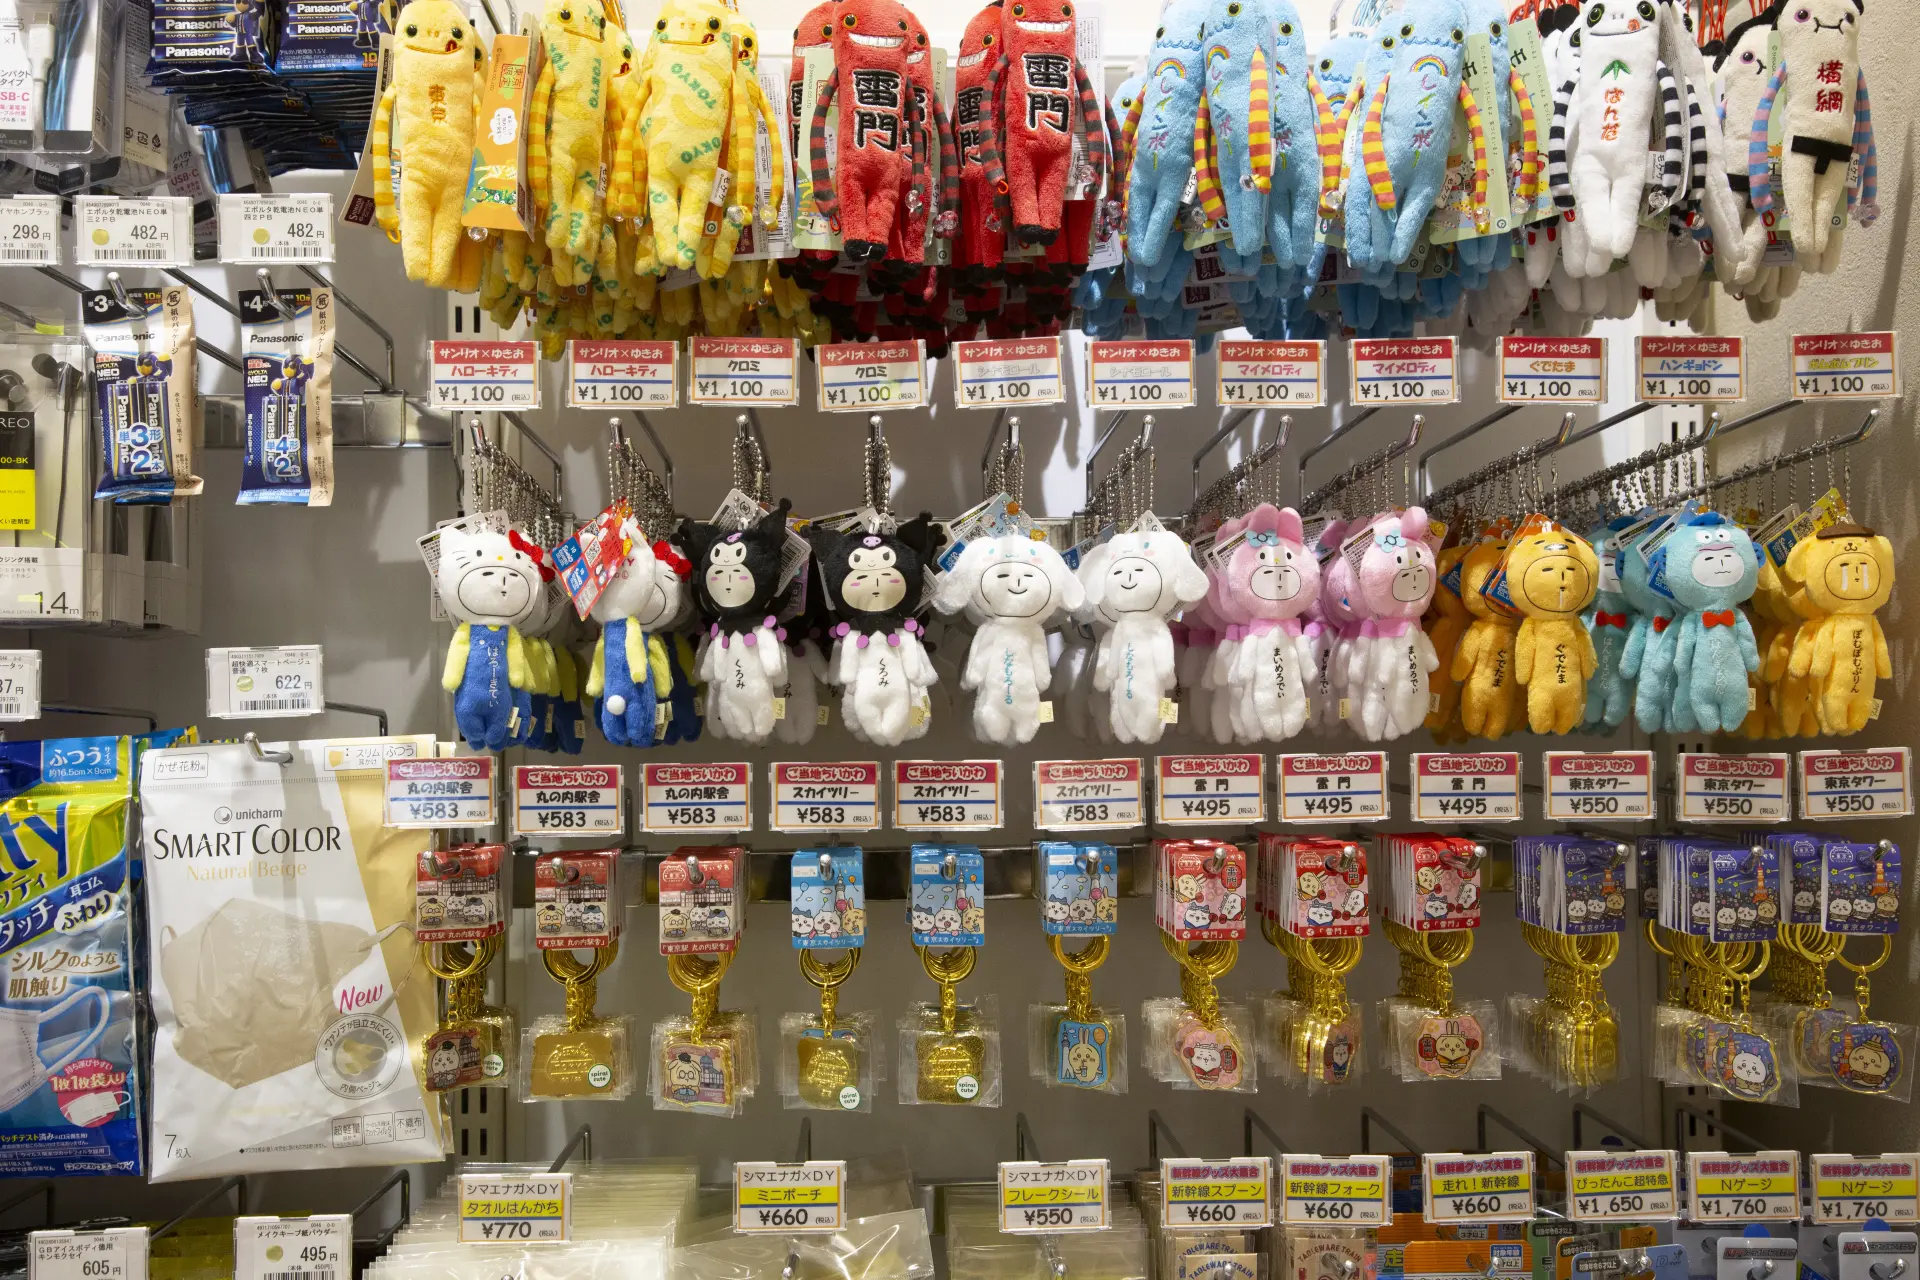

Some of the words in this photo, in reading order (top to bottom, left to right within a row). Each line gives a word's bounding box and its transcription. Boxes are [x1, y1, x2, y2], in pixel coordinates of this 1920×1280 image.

[297, 24, 353, 34] Panasonic
[165, 47, 231, 58] Panasonic
[1021, 53, 1073, 134] 雷門
[1815, 59, 1844, 114] 横綱
[852, 68, 903, 152] 雷門
[95, 331, 156, 343] Panasonic
[250, 332, 304, 344] Panasonic
[451, 365, 519, 377] ハローキティ
[590, 365, 657, 377] ハローキティ
[727, 360, 761, 372] クロミ
[855, 365, 888, 378] クロミ
[977, 362, 1041, 376] シナモロール
[1109, 364, 1172, 377] シナモロール
[1237, 363, 1302, 376] マイメロディ
[1372, 362, 1437, 374] マイメロディ
[1529, 360, 1576, 373] ぐでたま
[1660, 359, 1723, 371] ハンギョドン
[438, 385, 504, 403] ¥1,100
[578, 385, 643, 403] ¥1,100
[698, 380, 763, 398] ¥1,100
[966, 382, 1031, 401] ¥1,100
[1097, 385, 1162, 403] ¥1,100
[1225, 384, 1289, 402] ¥1,100
[1360, 382, 1424, 400] ¥1,100
[1507, 380, 1571, 399] ¥1,100
[1646, 379, 1711, 397] ¥1,100
[1799, 376, 1863, 395] ¥1,100
[827, 386, 891, 406] ¥1,100
[1554, 643, 1567, 684] ぐでたま
[735, 658, 746, 690] くろみ
[878, 658, 889, 688] くろみ
[49, 746, 101, 767] ふつう
[385, 745, 415, 758] ふつう
[398, 762, 480, 779] ご当地ちいかわ
[1048, 764, 1129, 780] ご当地ちいかわ
[1170, 758, 1250, 774] ご当地ちいかわ
[1292, 755, 1372, 773] ご当地ちいかわ
[1427, 757, 1508, 774] ご当地ちいかわ
[1561, 759, 1636, 774] ご当地ちいかわ
[1694, 759, 1775, 776] ご当地ちいかわ
[1814, 756, 1895, 773] ご当地ちいかわ
[527, 770, 609, 786] ご当地ちいかわ
[655, 766, 737, 783] ご当地ちいかわ
[786, 766, 867, 782] ご当地ちいかわ
[906, 765, 987, 781] ご当地ちいかわ
[1824, 775, 1886, 788] 東京タワー
[407, 782, 473, 795] 丸の内駅舎
[913, 785, 980, 798] スカイツリー
[1056, 783, 1122, 798] スカイツリー
[1569, 777, 1630, 790] 東京タワー
[1703, 778, 1766, 791] 東京タワー
[535, 791, 601, 804] 丸の内駅舎
[665, 787, 729, 800] 丸の内駅舎
[793, 786, 859, 799] スカイツリー
[409, 802, 459, 820] ¥583
[1182, 799, 1231, 816] ¥495
[1304, 797, 1353, 814] ¥495
[1439, 798, 1487, 815] ¥495
[1570, 797, 1619, 814] ¥550
[1704, 798, 1752, 815] ¥550
[1825, 795, 1874, 812] ¥550
[236, 808, 283, 820] unicharm
[537, 811, 586, 828] ¥583
[667, 807, 716, 824] ¥583
[797, 807, 845, 824] ¥583
[917, 805, 966, 822] ¥583
[1060, 804, 1109, 822] ¥583
[153, 828, 247, 860] SMART
[251, 823, 342, 855] COLOR
[186, 861, 251, 882] Natural
[258, 860, 307, 881] Beige
[68, 876, 104, 899] 耳ゴム
[61, 893, 111, 931] ふわり
[11, 948, 118, 973] シルクのような
[8, 974, 68, 1000] 肌触り
[339, 983, 384, 1014] New
[1172, 1183, 1263, 1198] 新幹線スプーン
[1290, 1180, 1381, 1195] 新幹線フォーク
[1721, 1179, 1773, 1191] Nゲージ
[1842, 1181, 1893, 1194] Nゲージ
[757, 1189, 822, 1202] ミニポーチ
[1008, 1187, 1100, 1202] フレークシール
[466, 1201, 559, 1215] タオルはんかち
[1187, 1204, 1236, 1222] ¥660
[1304, 1202, 1353, 1220] ¥660
[1453, 1195, 1501, 1214] ¥660
[1579, 1196, 1643, 1215] ¥1,650
[1701, 1199, 1767, 1217] ¥1,760
[1822, 1201, 1888, 1220] ¥1,760
[759, 1208, 808, 1226] ¥660
[1024, 1208, 1073, 1226] ¥550
[481, 1221, 532, 1239] ¥770
[1341, 1246, 1362, 1263] TRAIN
